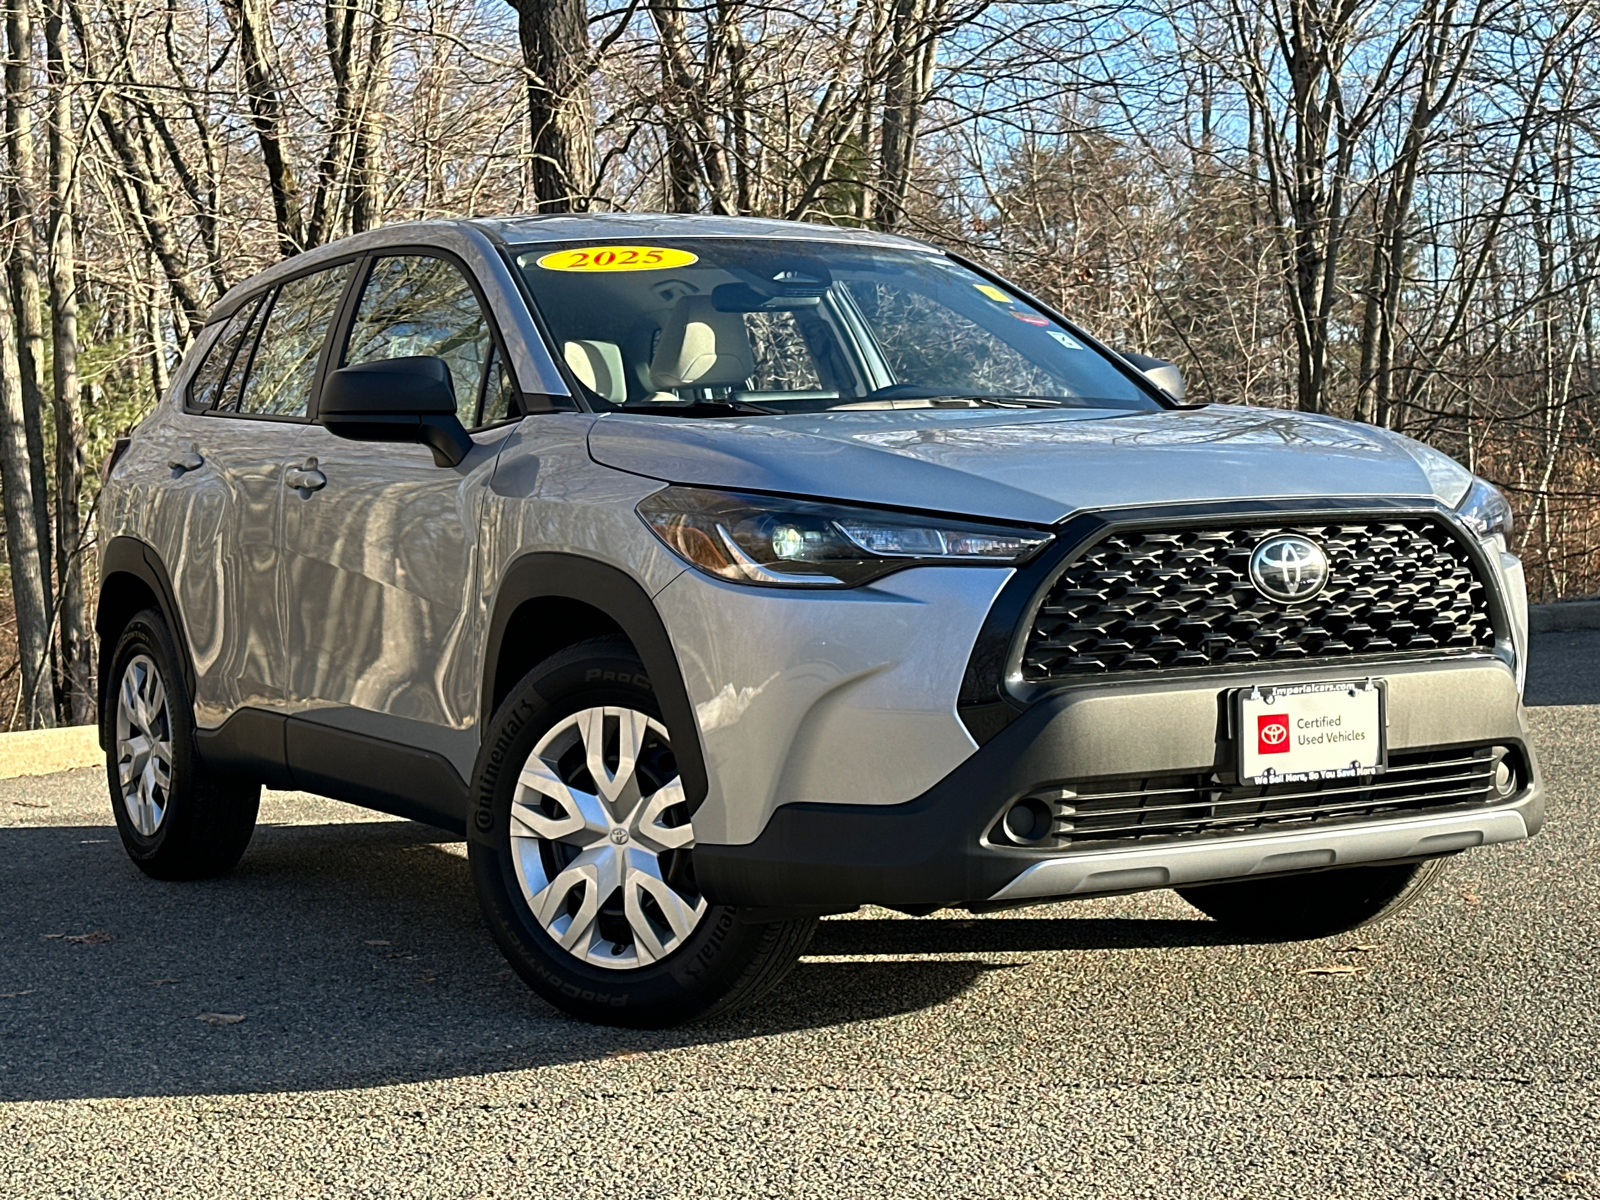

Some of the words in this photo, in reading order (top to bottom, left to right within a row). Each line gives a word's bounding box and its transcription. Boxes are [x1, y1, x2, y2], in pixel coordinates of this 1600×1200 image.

[568, 250, 665, 268] 2025
[1272, 683, 1356, 697] Imperialcars.com
[1296, 715, 1342, 730] Certified
[1297, 732, 1324, 746] Used
[1326, 729, 1366, 743] Vehicles
[475, 709, 526, 834] Continental
[1254, 775, 1268, 785] We
[1269, 773, 1284, 784] Sell
[1308, 771, 1319, 780] So
[1320, 770, 1335, 779] You
[1336, 768, 1356, 778] Save
[1357, 767, 1376, 776] More
